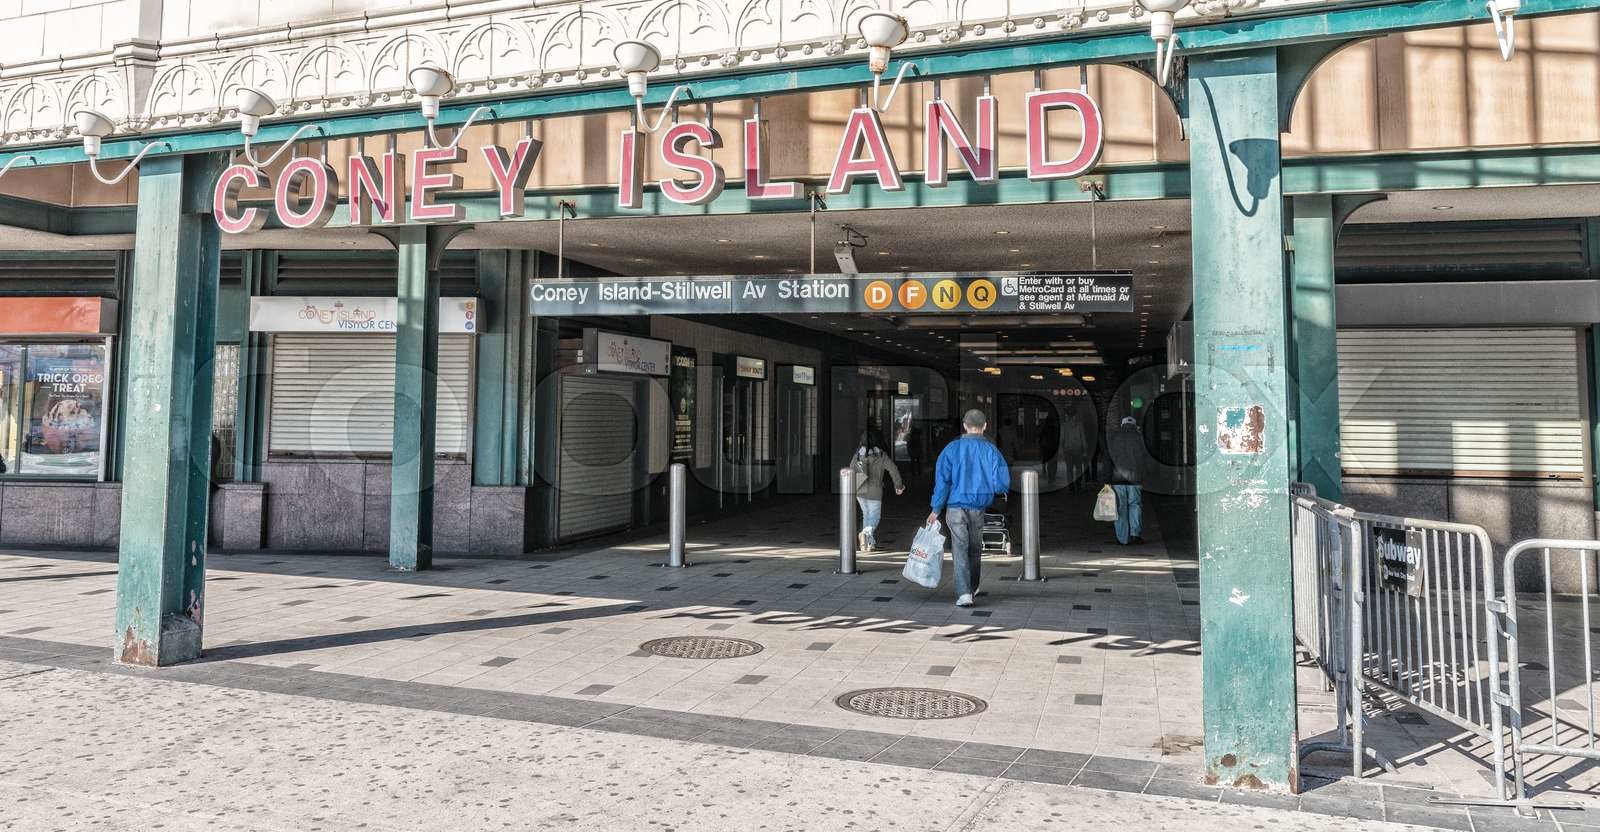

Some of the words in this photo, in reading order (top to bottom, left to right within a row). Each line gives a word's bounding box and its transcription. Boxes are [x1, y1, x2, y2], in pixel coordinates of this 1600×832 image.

[213, 137, 543, 234] CONEY
[618, 88, 1105, 208] ISLAND
[1019, 276, 1042, 285] Enter
[1044, 276, 1063, 285] with
[1078, 276, 1095, 286] buy
[530, 283, 588, 305] Coney
[598, 280, 732, 302] Island-Stillwell
[742, 280, 767, 299] Av
[777, 279, 850, 299] Station
[870, 285, 888, 305] D
[905, 285, 921, 304] F
[938, 285, 955, 304] N
[972, 284, 991, 304] Q
[1019, 285, 1065, 294] MetroCard
[1067, 285, 1076, 294] at
[1079, 285, 1089, 294] all
[1092, 285, 1117, 294] times
[1119, 286, 1130, 294] or
[1019, 294, 1036, 302] see
[1038, 294, 1063, 303] agent
[1066, 294, 1076, 302] at
[1078, 294, 1116, 302] Mermaid
[1118, 293, 1130, 302] Av
[1019, 302, 1026, 310] &
[1029, 301, 1061, 310] Stillwell
[1064, 302, 1075, 310] Av
[378, 320, 399, 330] CEN
[37, 373, 69, 383] TRICK
[52, 383, 87, 393] TREAT
[1376, 535, 1422, 571] Subway
